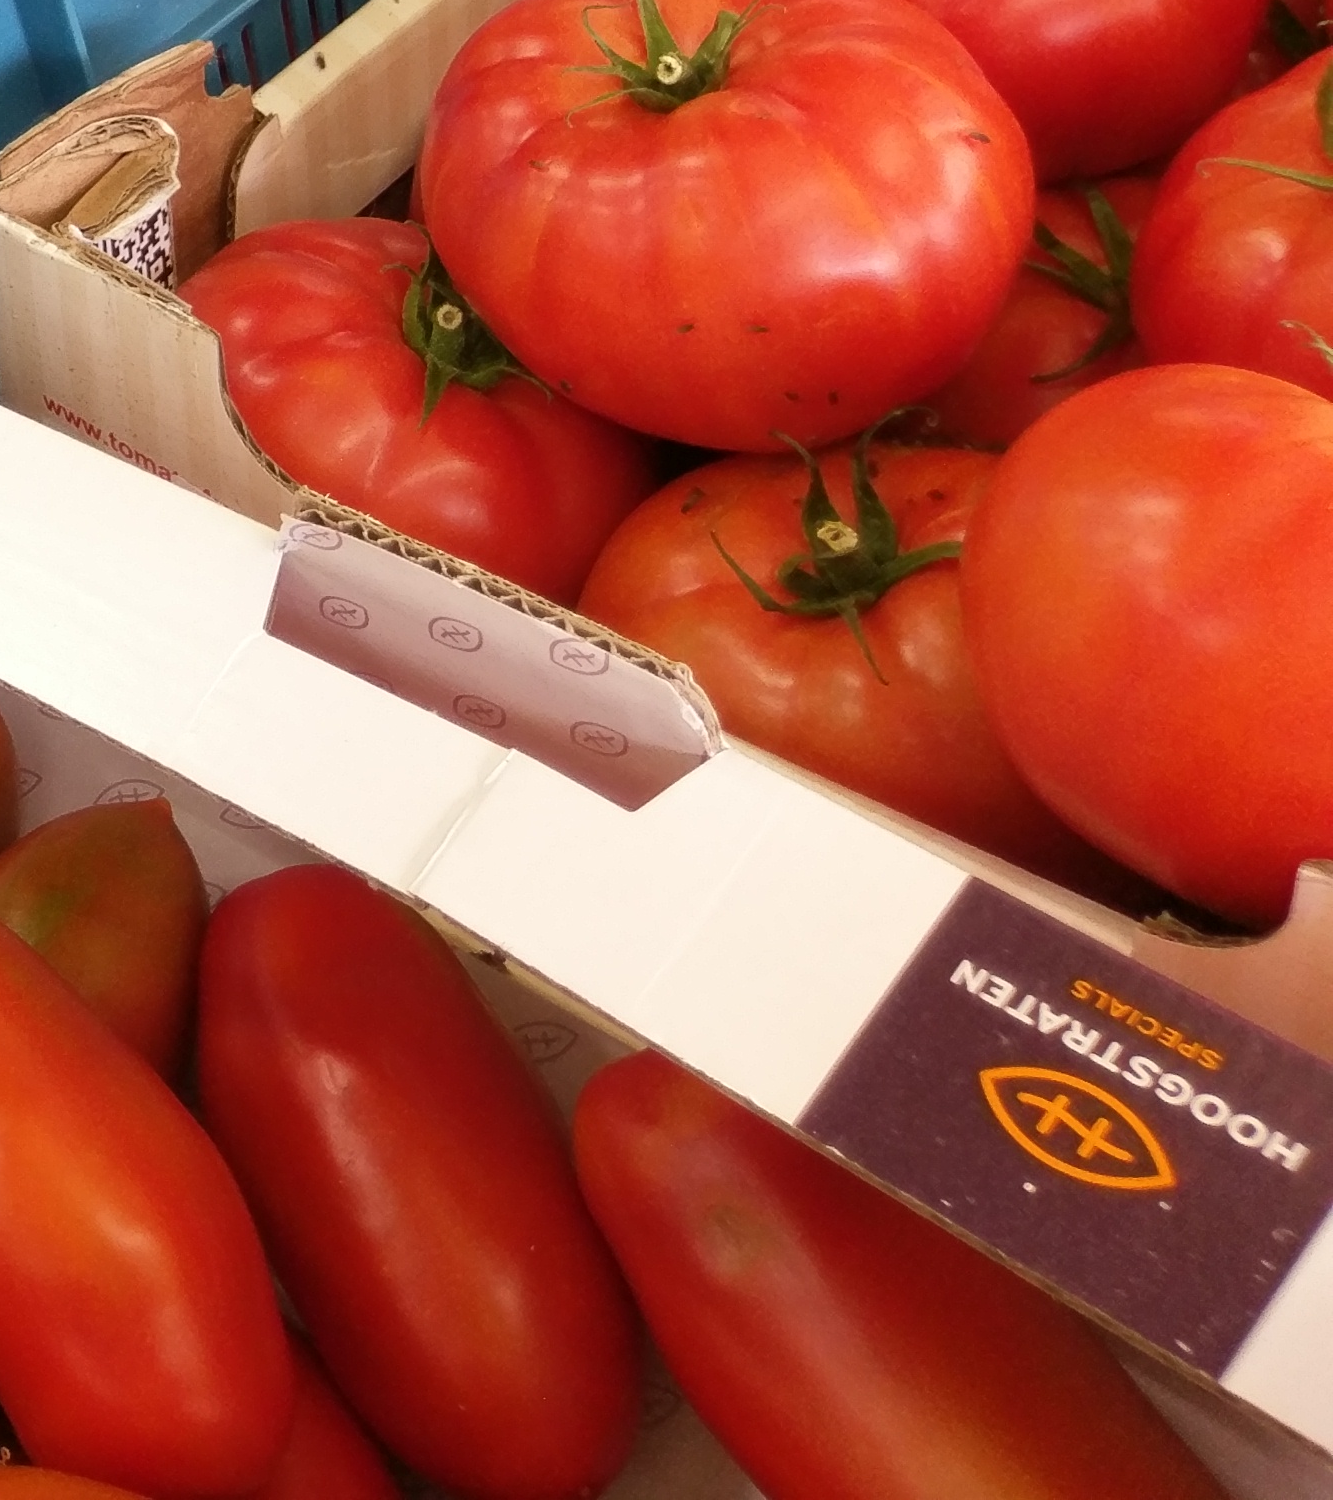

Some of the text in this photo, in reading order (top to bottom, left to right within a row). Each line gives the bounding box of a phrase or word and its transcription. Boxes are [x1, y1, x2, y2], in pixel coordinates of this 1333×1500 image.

[42, 394, 179, 483] www.toma
[949, 958, 1311, 1173] HOOGSTRATEN
[1069, 978, 1226, 1072] SPECIALS
